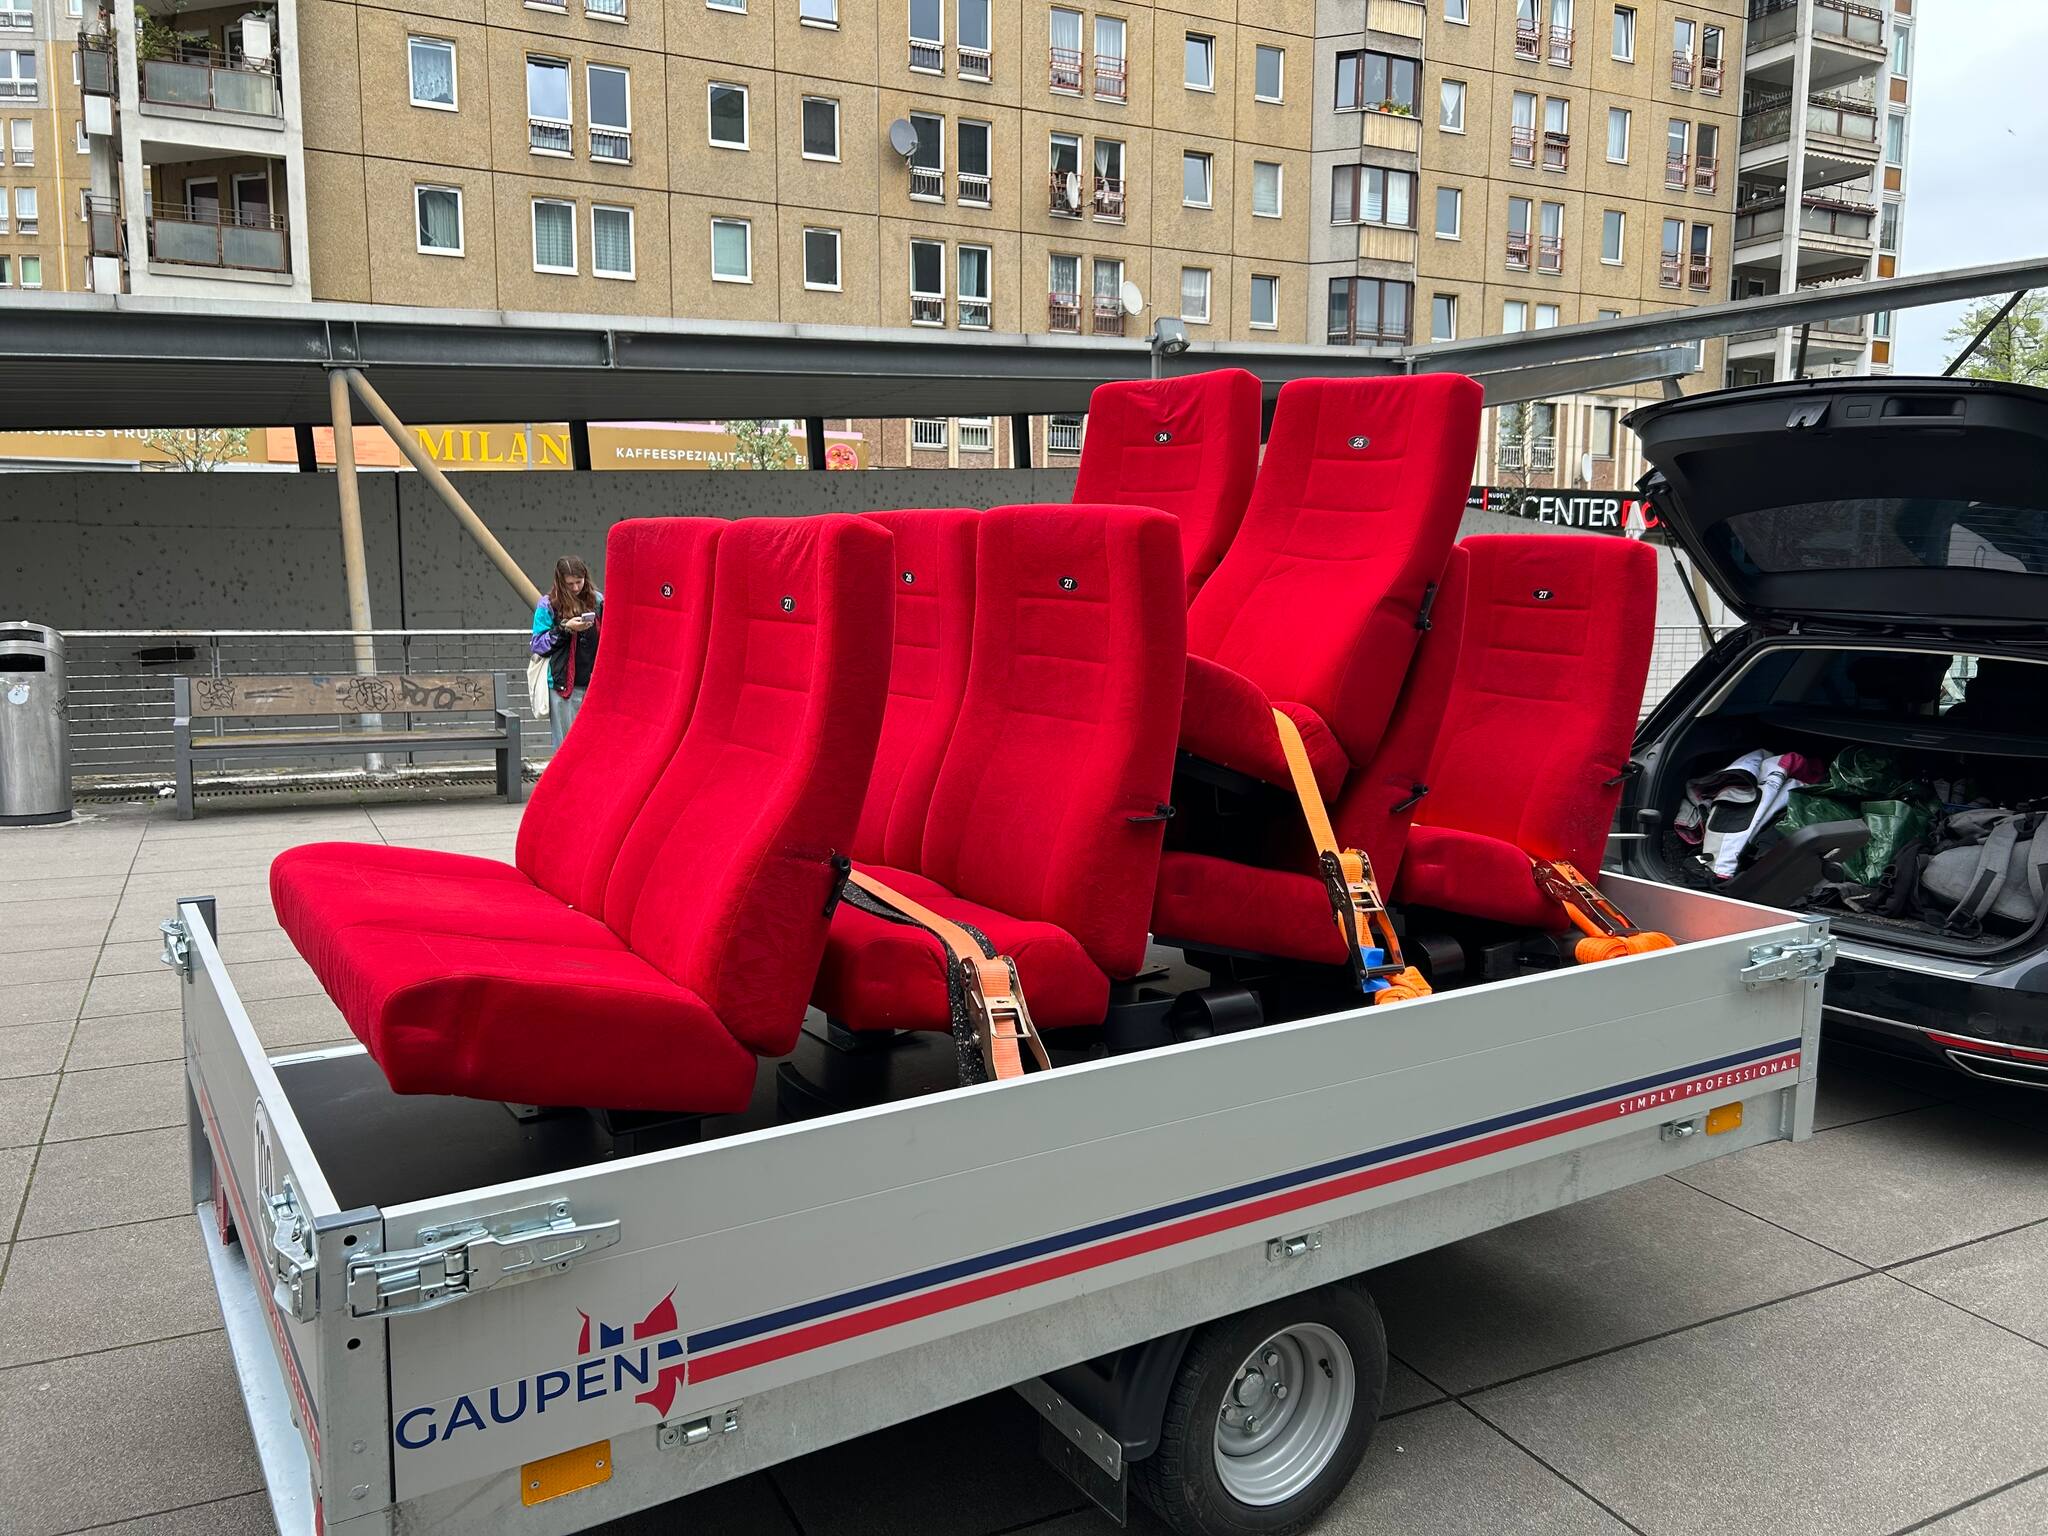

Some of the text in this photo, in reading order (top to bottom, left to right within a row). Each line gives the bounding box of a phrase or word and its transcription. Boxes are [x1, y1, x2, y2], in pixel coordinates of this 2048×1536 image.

[1159, 433, 1168, 442] 24
[1353, 438, 1364, 447] 25
[416, 428, 570, 465] MILAN
[1520, 496, 1618, 527] CENTER
[1064, 578, 1074, 589] 27
[1538, 590, 1548, 599] 27
[784, 598, 792, 610] 27
[1619, 1058, 1797, 1114] SIMPLY PROFESSIONAL
[395, 1347, 649, 1450] GAUPEN
